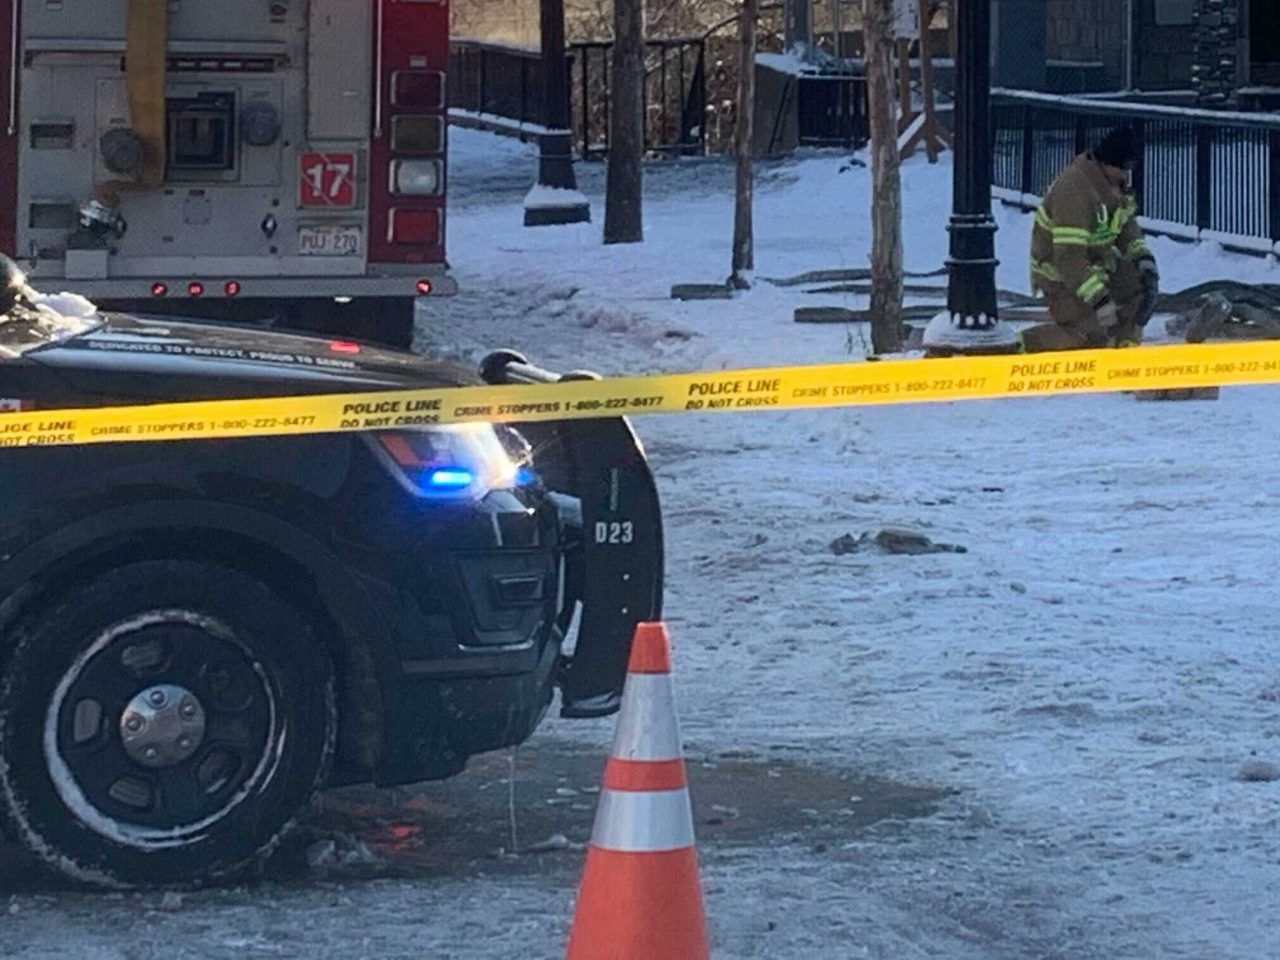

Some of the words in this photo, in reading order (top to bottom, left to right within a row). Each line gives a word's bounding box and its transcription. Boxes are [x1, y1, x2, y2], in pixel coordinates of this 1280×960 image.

[307, 163, 350, 197] 17
[1010, 362, 1061, 376] POLICE
[1065, 359, 1097, 373] LINE
[688, 381, 742, 396] POLICE
[747, 379, 781, 392] LINE
[792, 386, 828, 399] CRIME
[832, 383, 890, 396] STOPPERS
[1007, 380, 1025, 391] DO
[1028, 378, 1052, 389] NOT
[1054, 376, 1095, 389] CROSS
[343, 400, 400, 415] POLICE
[406, 398, 443, 412] LINE
[497, 402, 559, 415] STOPPERS
[685, 398, 704, 410] DO
[707, 397, 731, 408] NOT
[736, 395, 779, 407] CROSS
[0, 422, 33, 434] ICE
[38, 420, 77, 432] LINE
[340, 417, 359, 428] DO
[363, 416, 392, 427] NOT
[394, 415, 440, 426] CROSS
[27, 434, 75, 446] CROSS
[595, 521, 633, 543] D23
